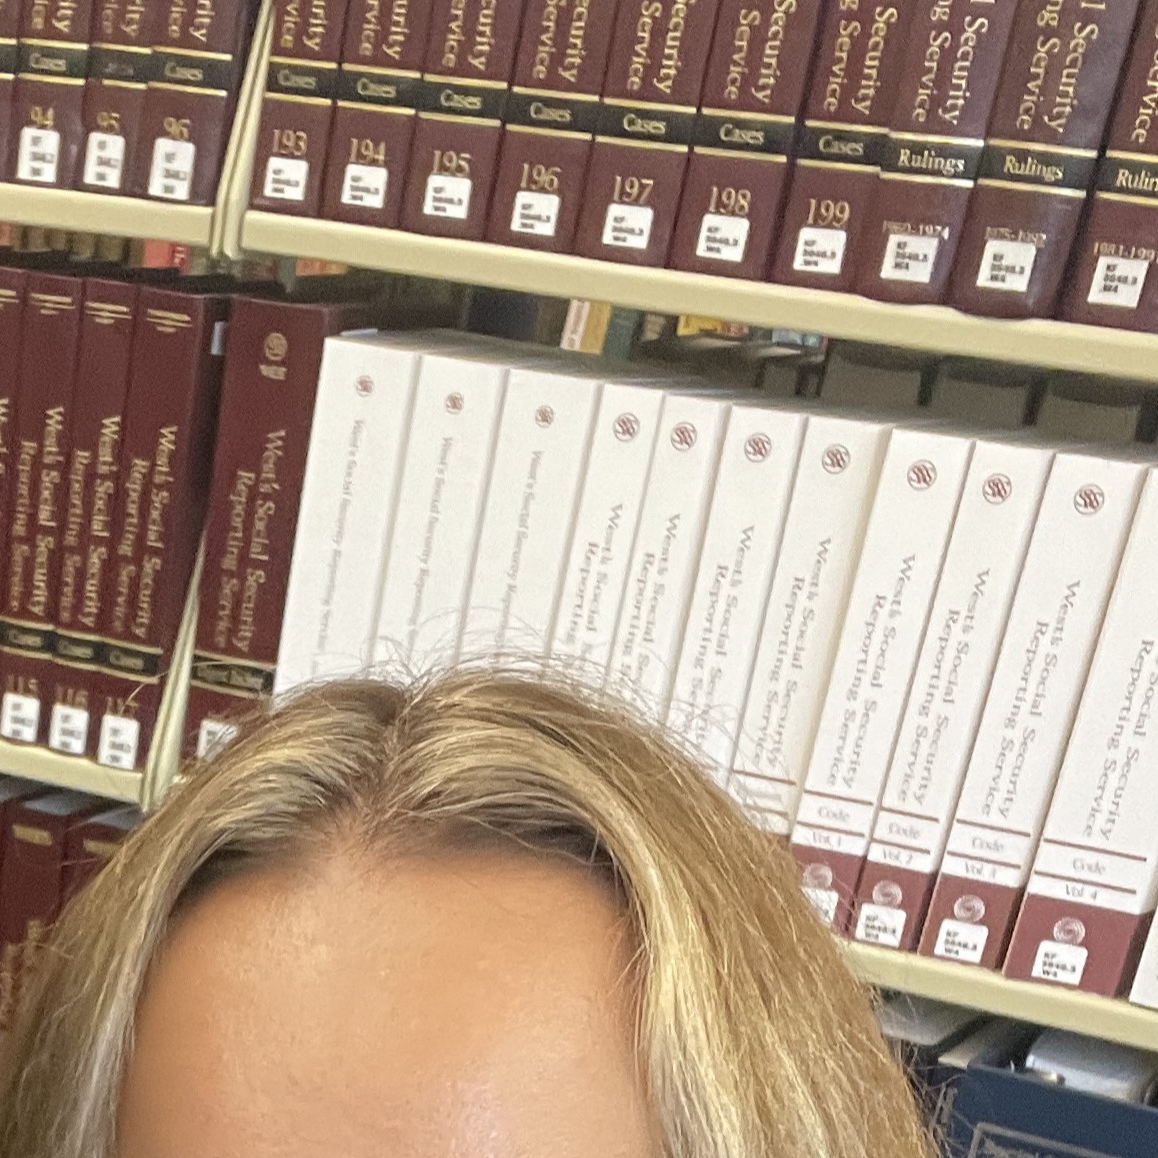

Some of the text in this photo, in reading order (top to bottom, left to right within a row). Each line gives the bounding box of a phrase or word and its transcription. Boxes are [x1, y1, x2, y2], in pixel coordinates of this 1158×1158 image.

[626, 1, 663, 91] Service
[653, 0, 694, 94] ecurity
[724, 9, 761, 100] Service
[751, 0, 797, 104] Security
[823, 20, 861, 112] Service
[851, 7, 898, 115] Security
[912, 30, 952, 122] Service
[938, 16, 989, 126] Security
[1043, 22, 1099, 133] Security
[441, 89, 481, 109] Cases
[530, 102, 572, 121] Cases
[1016, 36, 1061, 130] Service
[30, 106, 55, 128] 94
[97, 111, 120, 133] 95
[163, 117, 191, 140] 96
[272, 129, 308, 155] 193
[623, 113, 666, 135] Cases
[720, 124, 764, 145] Cases
[819, 135, 864, 155] Cases
[349, 138, 387, 164] 194
[433, 150, 473, 178] 195
[520, 163, 562, 191] 196
[897, 147, 965, 175] Rulings
[1003, 155, 1064, 182] Rulings
[613, 175, 654, 203] 197
[709, 186, 752, 215] 198
[807, 198, 851, 226] 199
[96, 415, 122, 474] West's
[91, 479, 114, 538] Social
[131, 425, 179, 639] West's Social Security
[231, 429, 287, 653] West's Social Security
[806, 536, 832, 601] West's
[587, 571, 609, 633] Social
[622, 552, 655, 656] Reporting
[643, 513, 681, 644] West's Social
[715, 525, 755, 657] West's Social
[694, 564, 730, 670] Reporting
[769, 576, 805, 682] Reporting
[791, 606, 815, 670] Social
[827, 594, 888, 788] Reporting Service
[843, 554, 917, 789] West's Social Security
[913, 568, 991, 806] West's Social Security
[998, 580, 1081, 820] West's Social Security
[898, 608, 961, 804] Reporting Service
[982, 620, 1050, 818] Reporting Service
[1083, 639, 1155, 838] Reporting Service
[818, 806, 850, 823] Code
[1100, 746, 1140, 841] Security
[888, 822, 921, 838] Code
[971, 836, 1005, 851] Code
[1065, 883, 1098, 901] Vol. 4
[1072, 859, 1106, 875] Code
